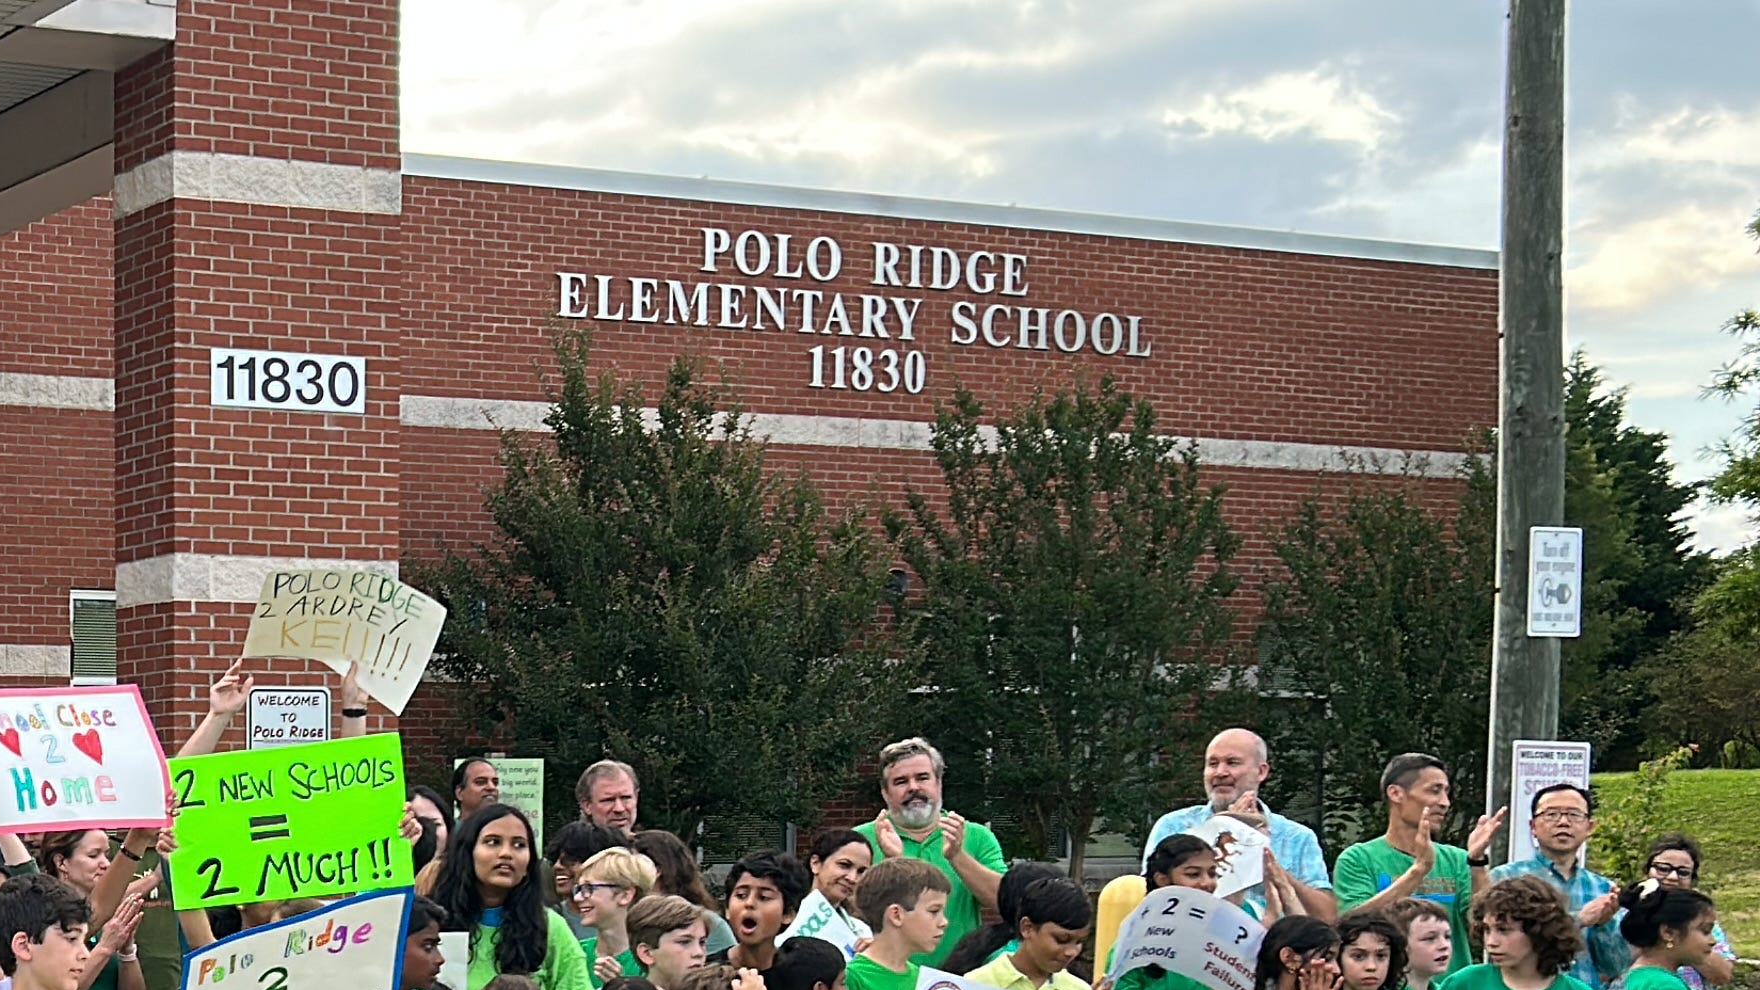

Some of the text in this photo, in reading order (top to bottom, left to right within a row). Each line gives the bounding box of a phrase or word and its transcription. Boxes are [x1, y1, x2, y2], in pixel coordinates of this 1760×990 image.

[700, 227, 1029, 297] POLO RIDGE
[556, 271, 1152, 358] ELEMENTARY SCHOOL
[216, 355, 359, 407] 11830
[808, 344, 926, 395] 11830
[258, 596, 409, 636] 2 ARDREY
[273, 571, 426, 620] POLO RIDGE
[56, 703, 117, 728] Close
[257, 695, 320, 706] WELCOME
[280, 713, 297, 723] TO
[40, 733, 66, 764] 2
[9, 766, 117, 812] Home
[174, 757, 395, 808] 2 NEW SCHOOLS
[196, 857, 239, 900] 2
[1161, 897, 1180, 915] 2
[197, 919, 373, 985] Polo Ridge
